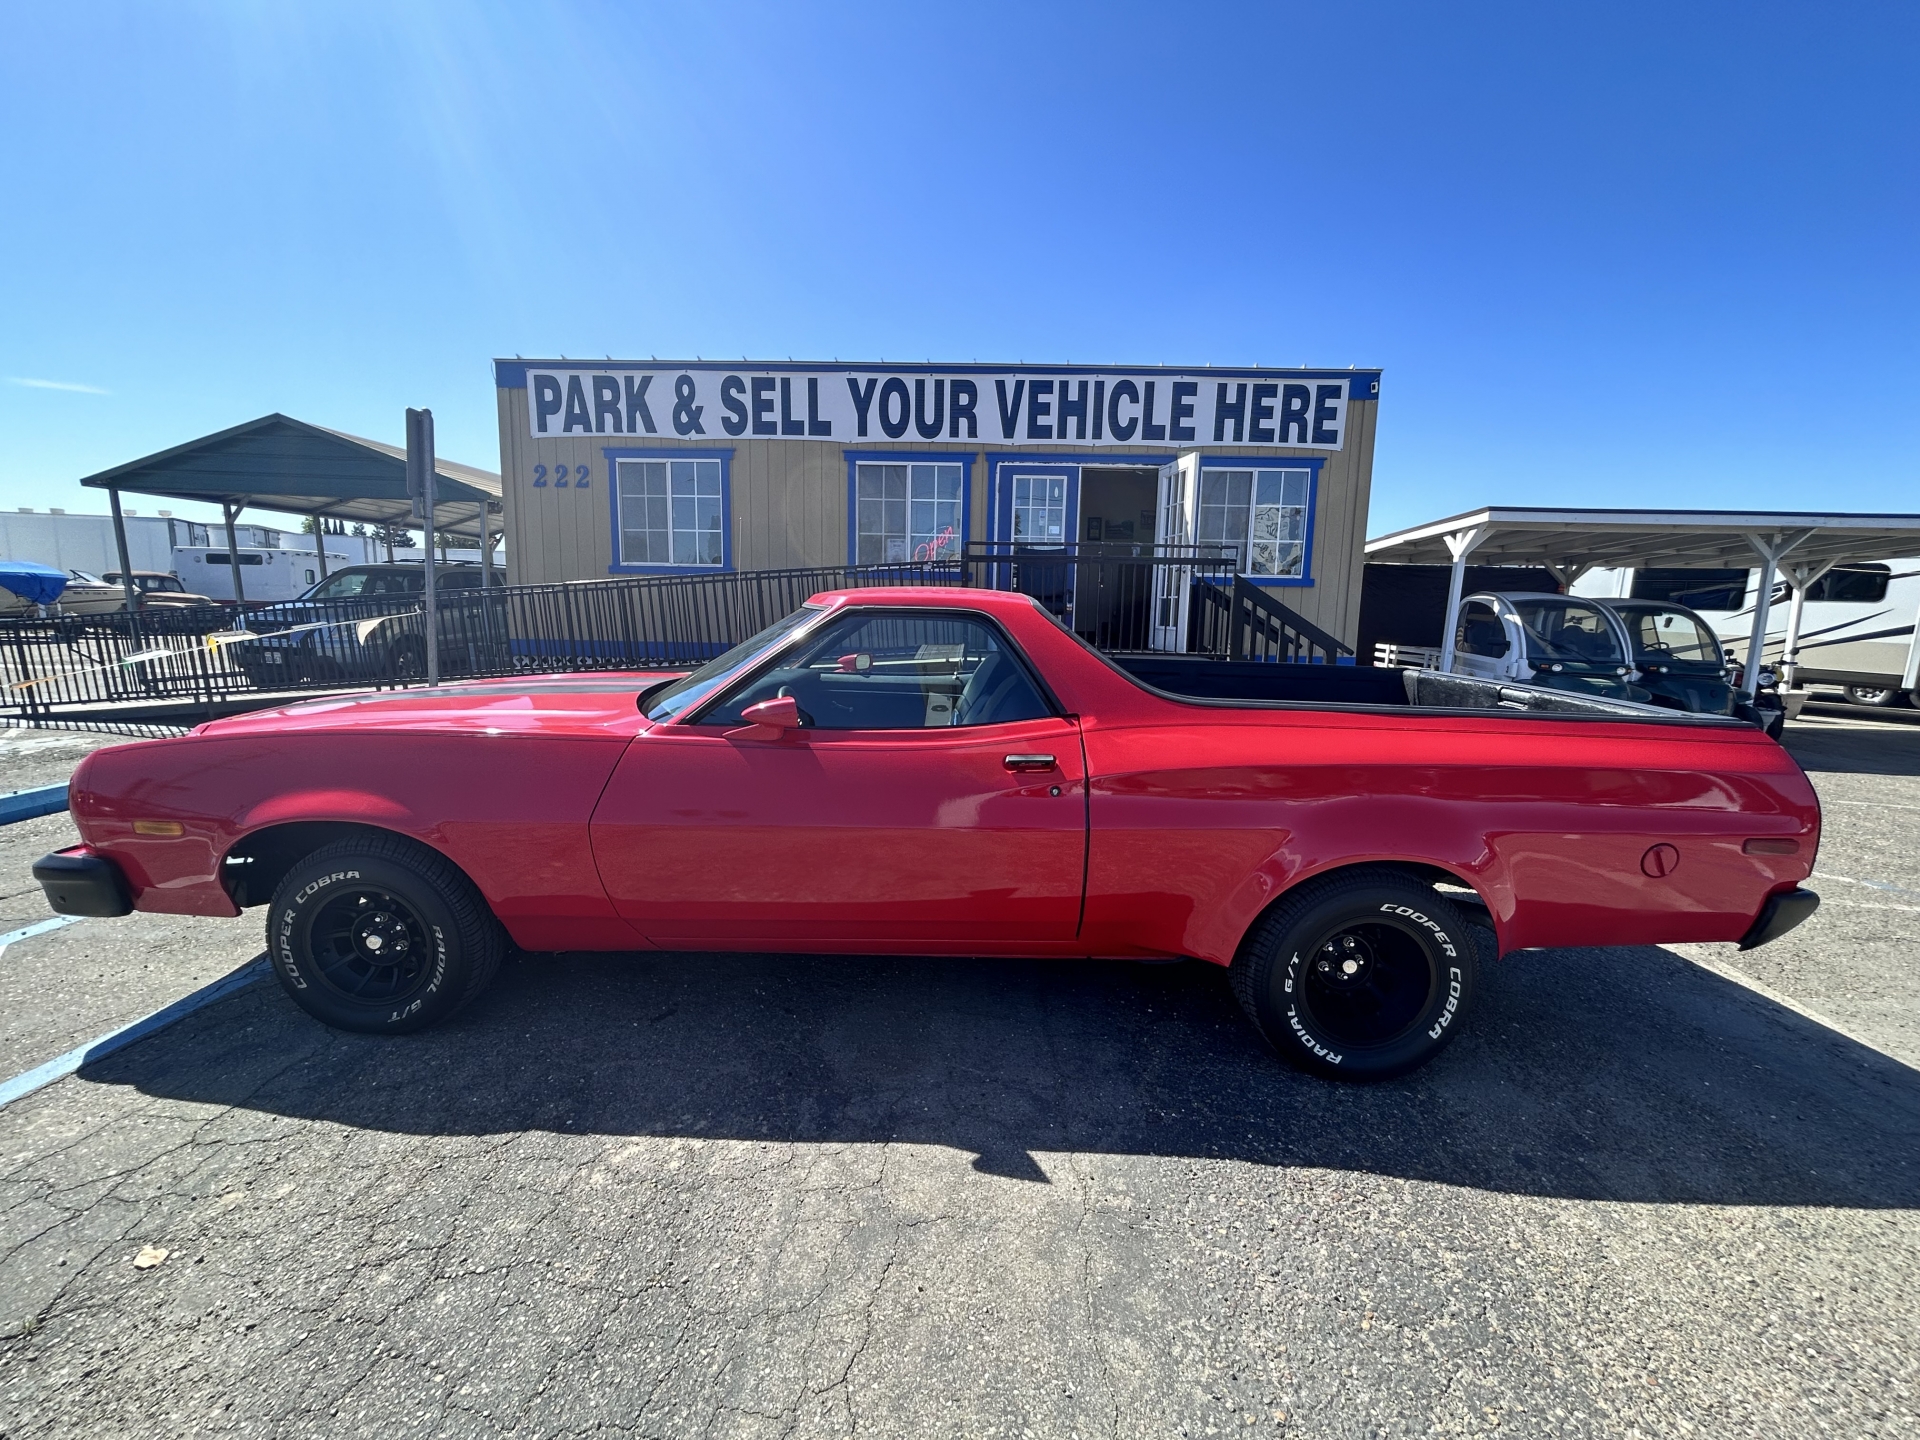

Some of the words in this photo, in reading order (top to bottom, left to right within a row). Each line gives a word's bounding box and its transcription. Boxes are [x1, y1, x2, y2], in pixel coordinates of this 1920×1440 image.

[533, 374, 658, 434] PARK
[672, 374, 706, 436] &
[720, 374, 832, 436] SELL
[847, 377, 978, 440] YOUR
[995, 379, 1198, 442] VEHICLE
[1213, 382, 1343, 445] HERE
[533, 464, 590, 488] 222
[915, 526, 953, 561] Open
[280, 908, 307, 989] COOPER
[295, 870, 360, 904] COBRA
[426, 925, 446, 993] RADIAL
[1284, 951, 1300, 993] G/T
[1379, 903, 1457, 957] COOPER
[1428, 966, 1462, 1039] COBRA
[387, 999, 422, 1022] G/T
[1287, 1003, 1343, 1064] RADIAL
